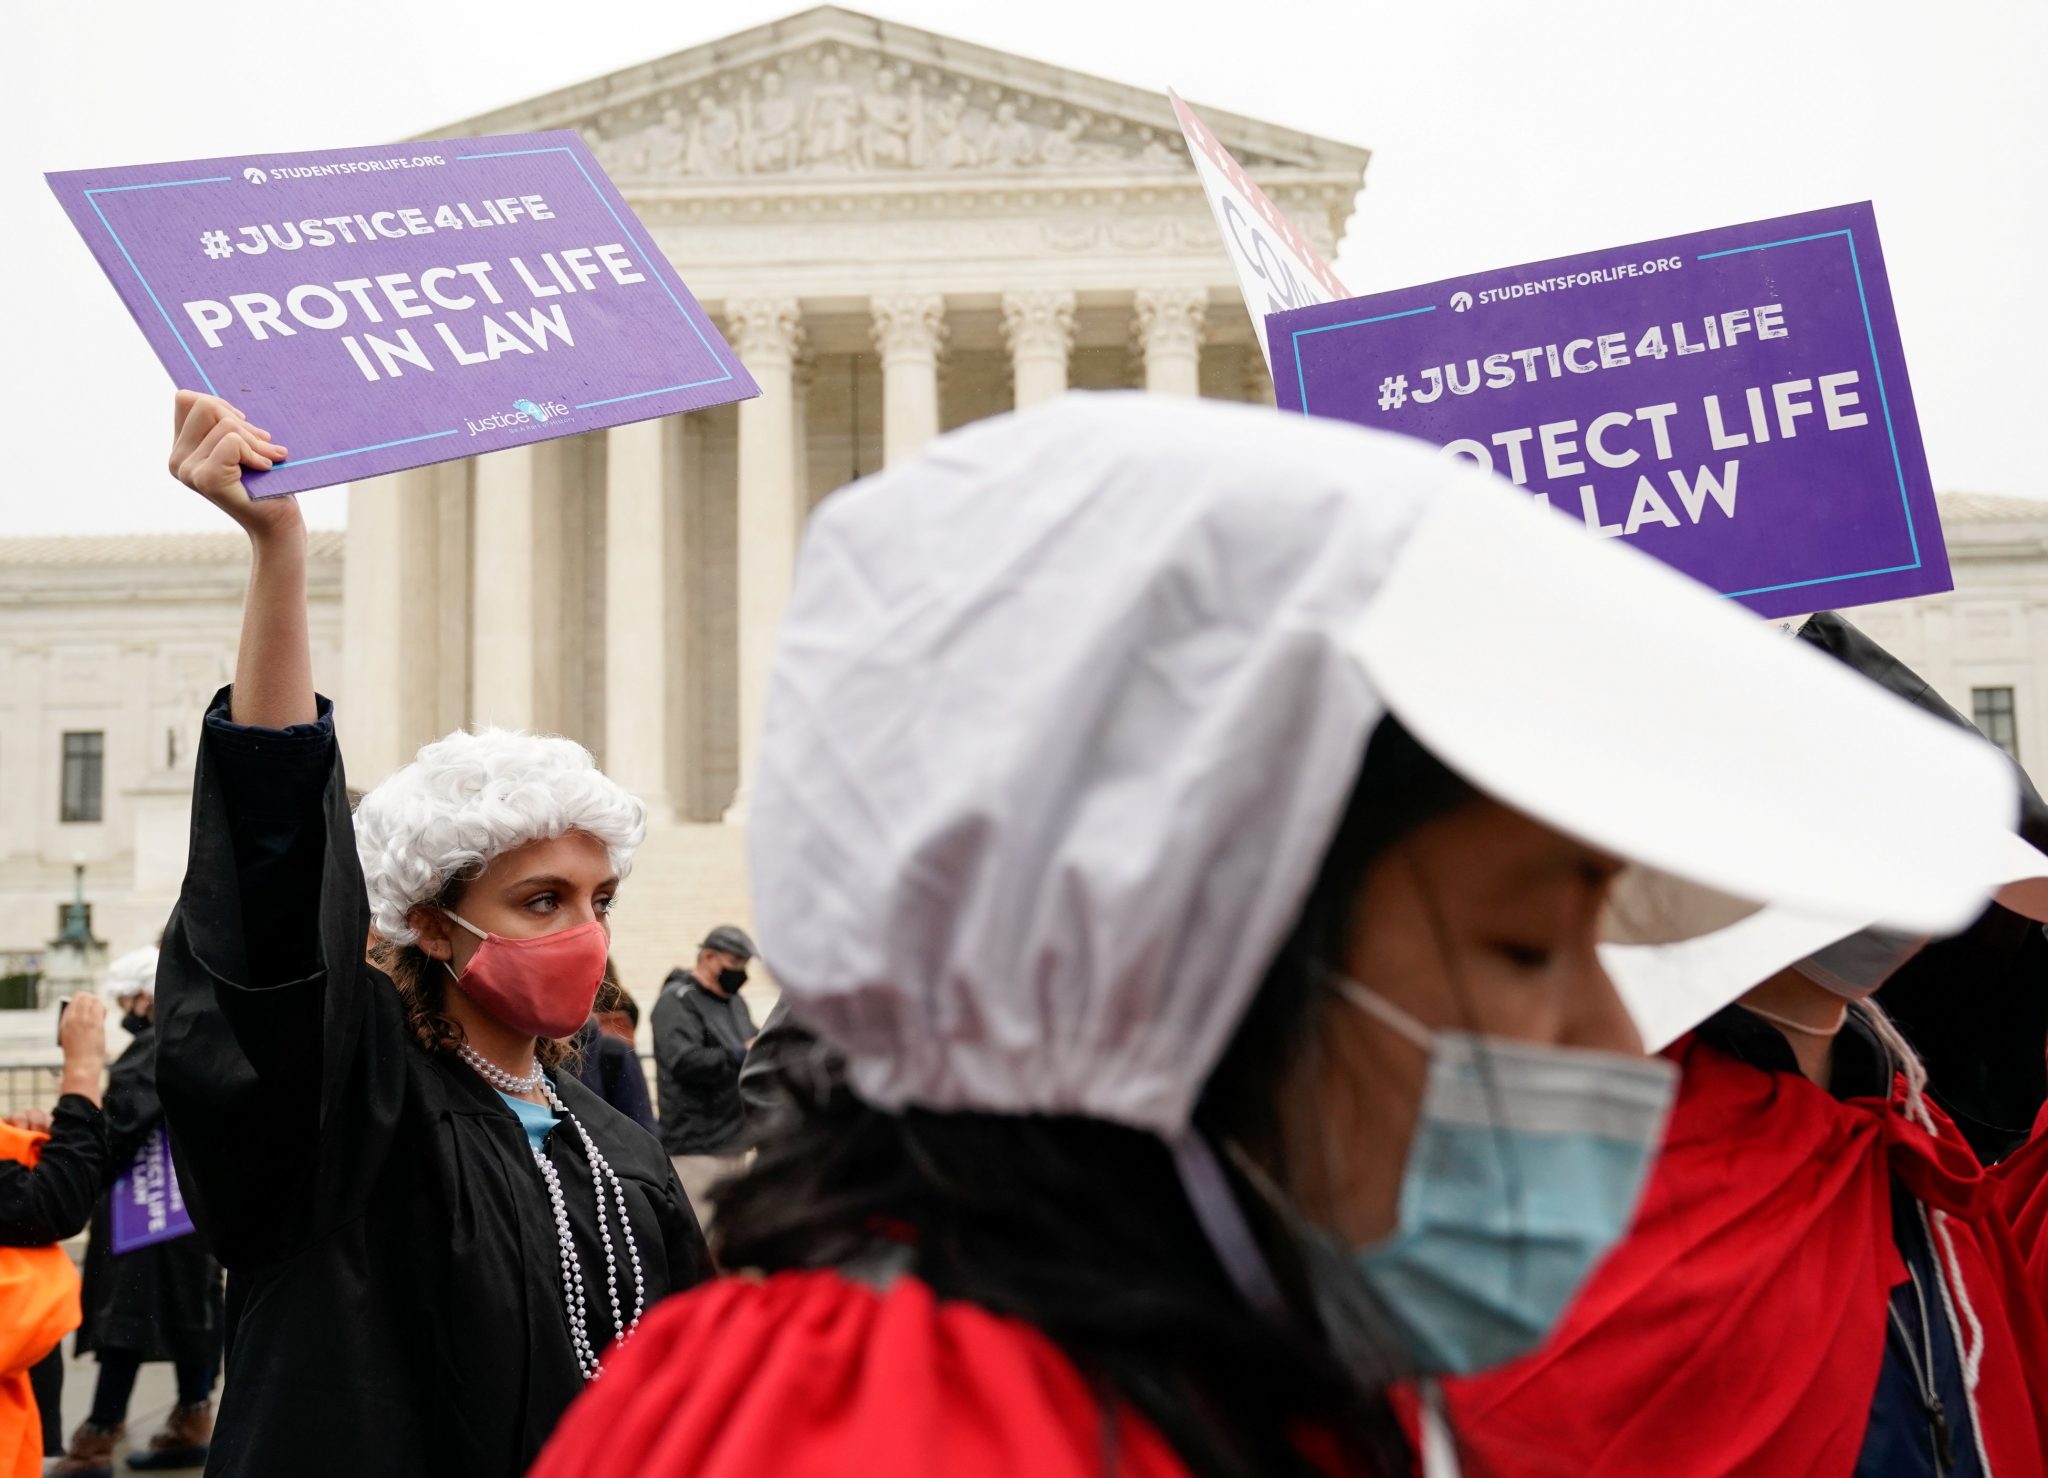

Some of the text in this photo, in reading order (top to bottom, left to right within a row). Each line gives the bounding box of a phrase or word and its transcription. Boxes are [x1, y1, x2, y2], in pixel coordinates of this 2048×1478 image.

[270, 154, 446, 181] STUDENTSFORLIFE.ORG
[200, 194, 556, 260] #JUSTICE4LIFE
[182, 243, 646, 348] PROTECT LIFE
[1478, 255, 1683, 305] STUDENTSFORLIFE.ORG
[340, 303, 575, 382] IN LAW
[1377, 303, 1789, 411] #JUSTICE4LIFE
[1703, 370, 1869, 451] LIFE
[1579, 459, 1740, 540] LAW
